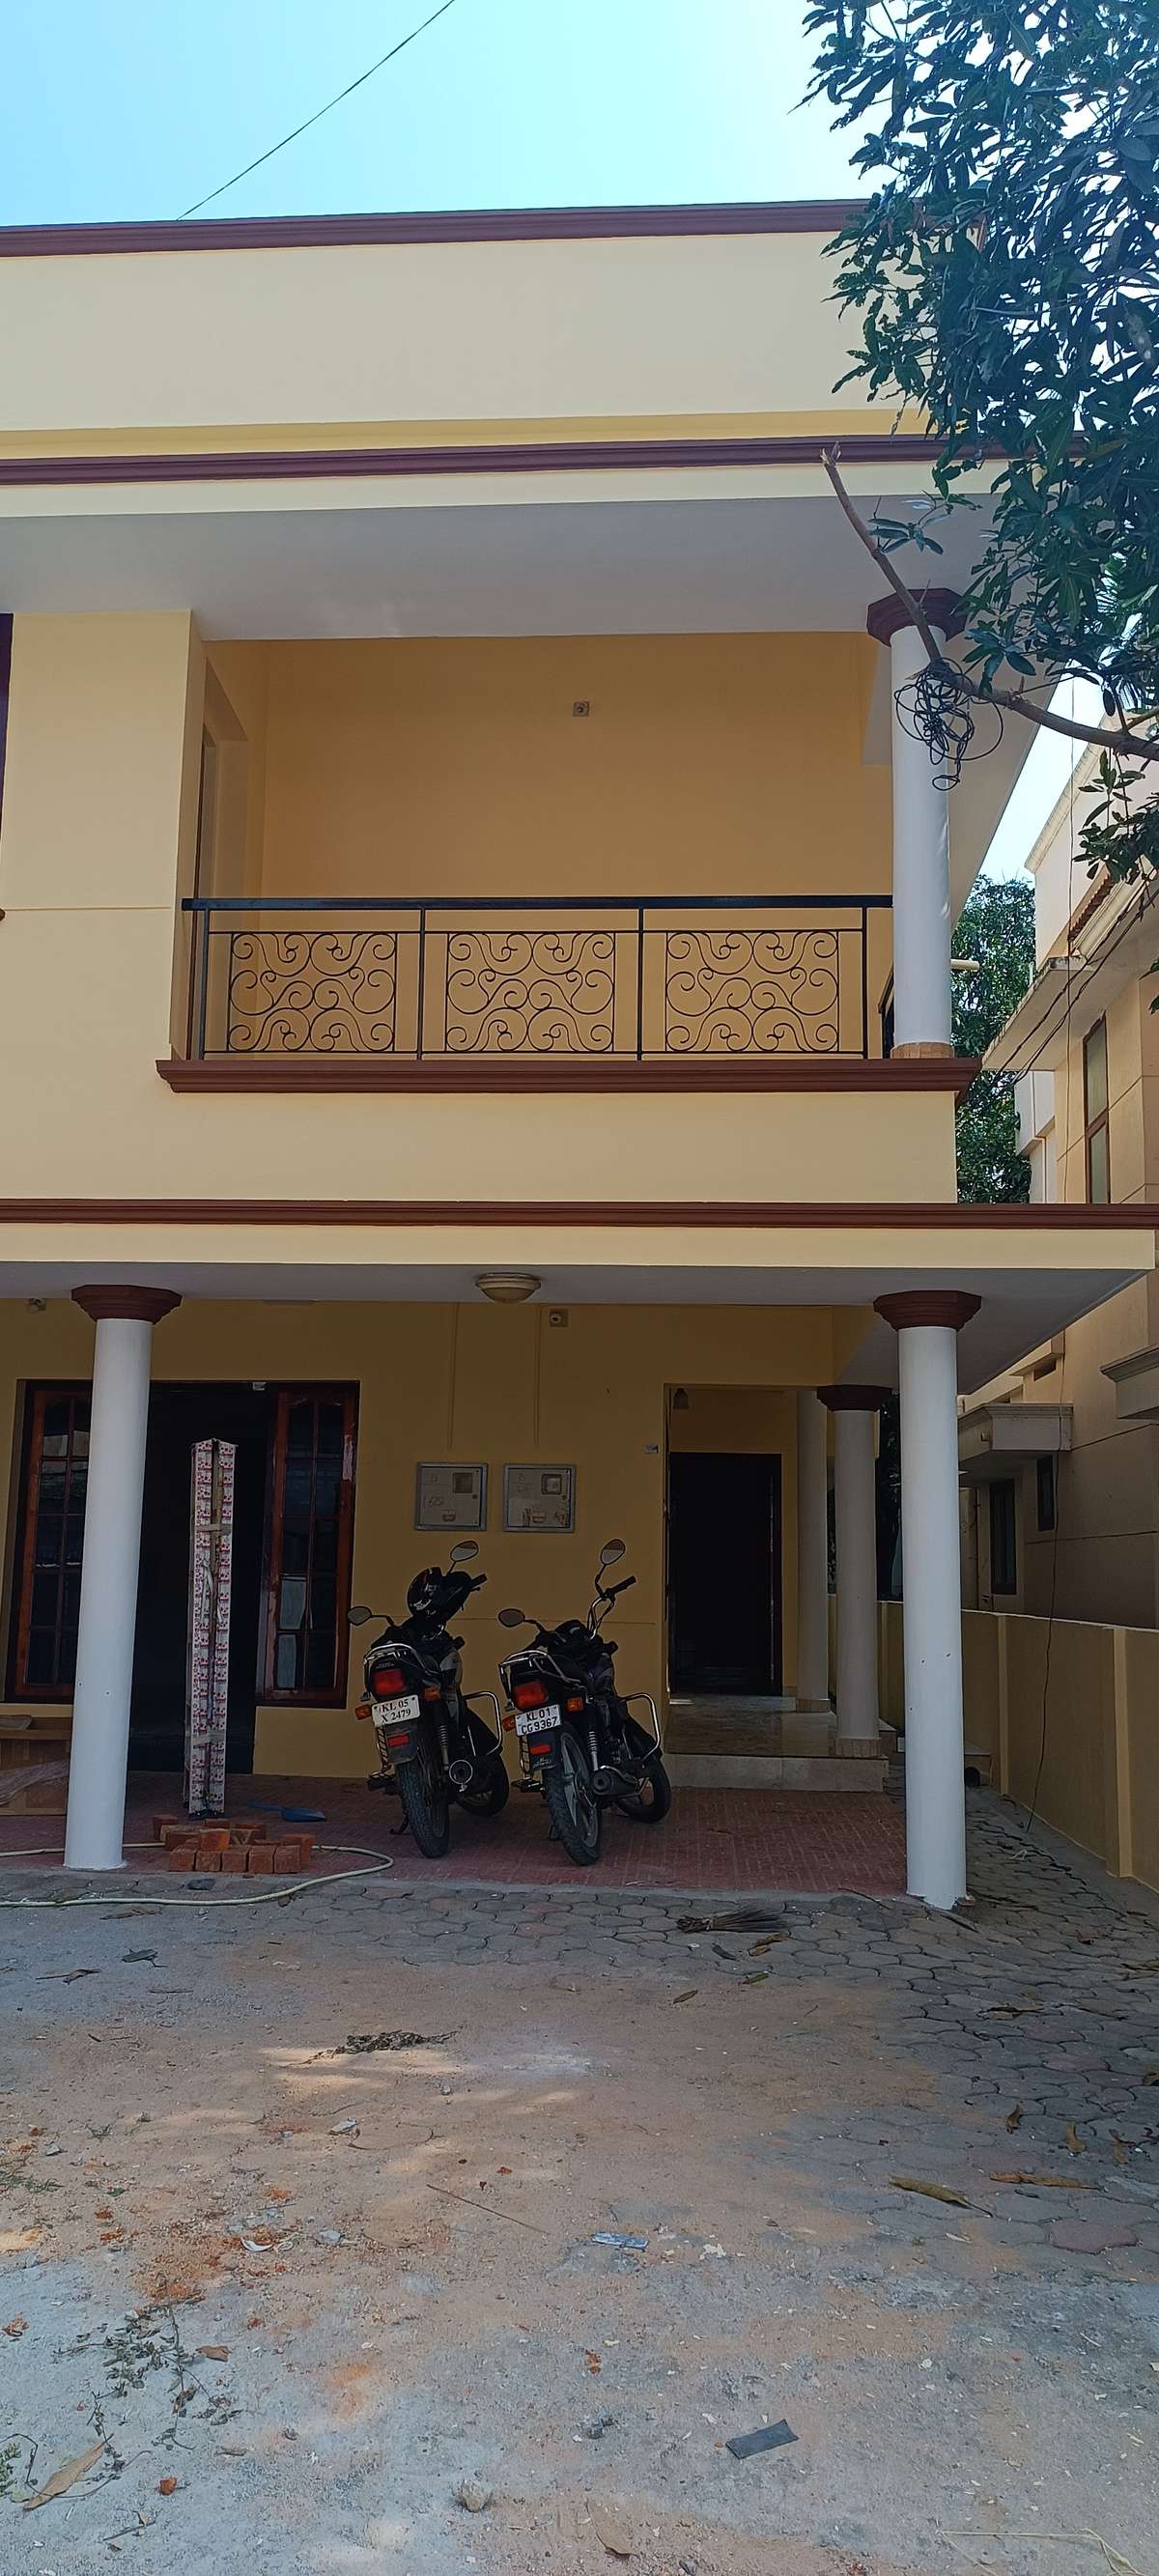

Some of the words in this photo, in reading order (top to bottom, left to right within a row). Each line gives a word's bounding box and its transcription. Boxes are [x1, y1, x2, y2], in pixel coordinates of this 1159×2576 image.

[382, 1703, 396, 1713] KL
[398, 1699, 409, 1708] 05
[390, 1709, 411, 1720] 2479
[526, 1712, 538, 1722] KL
[539, 1708, 551, 1718] 01
[522, 1716, 557, 1735] CG9367
